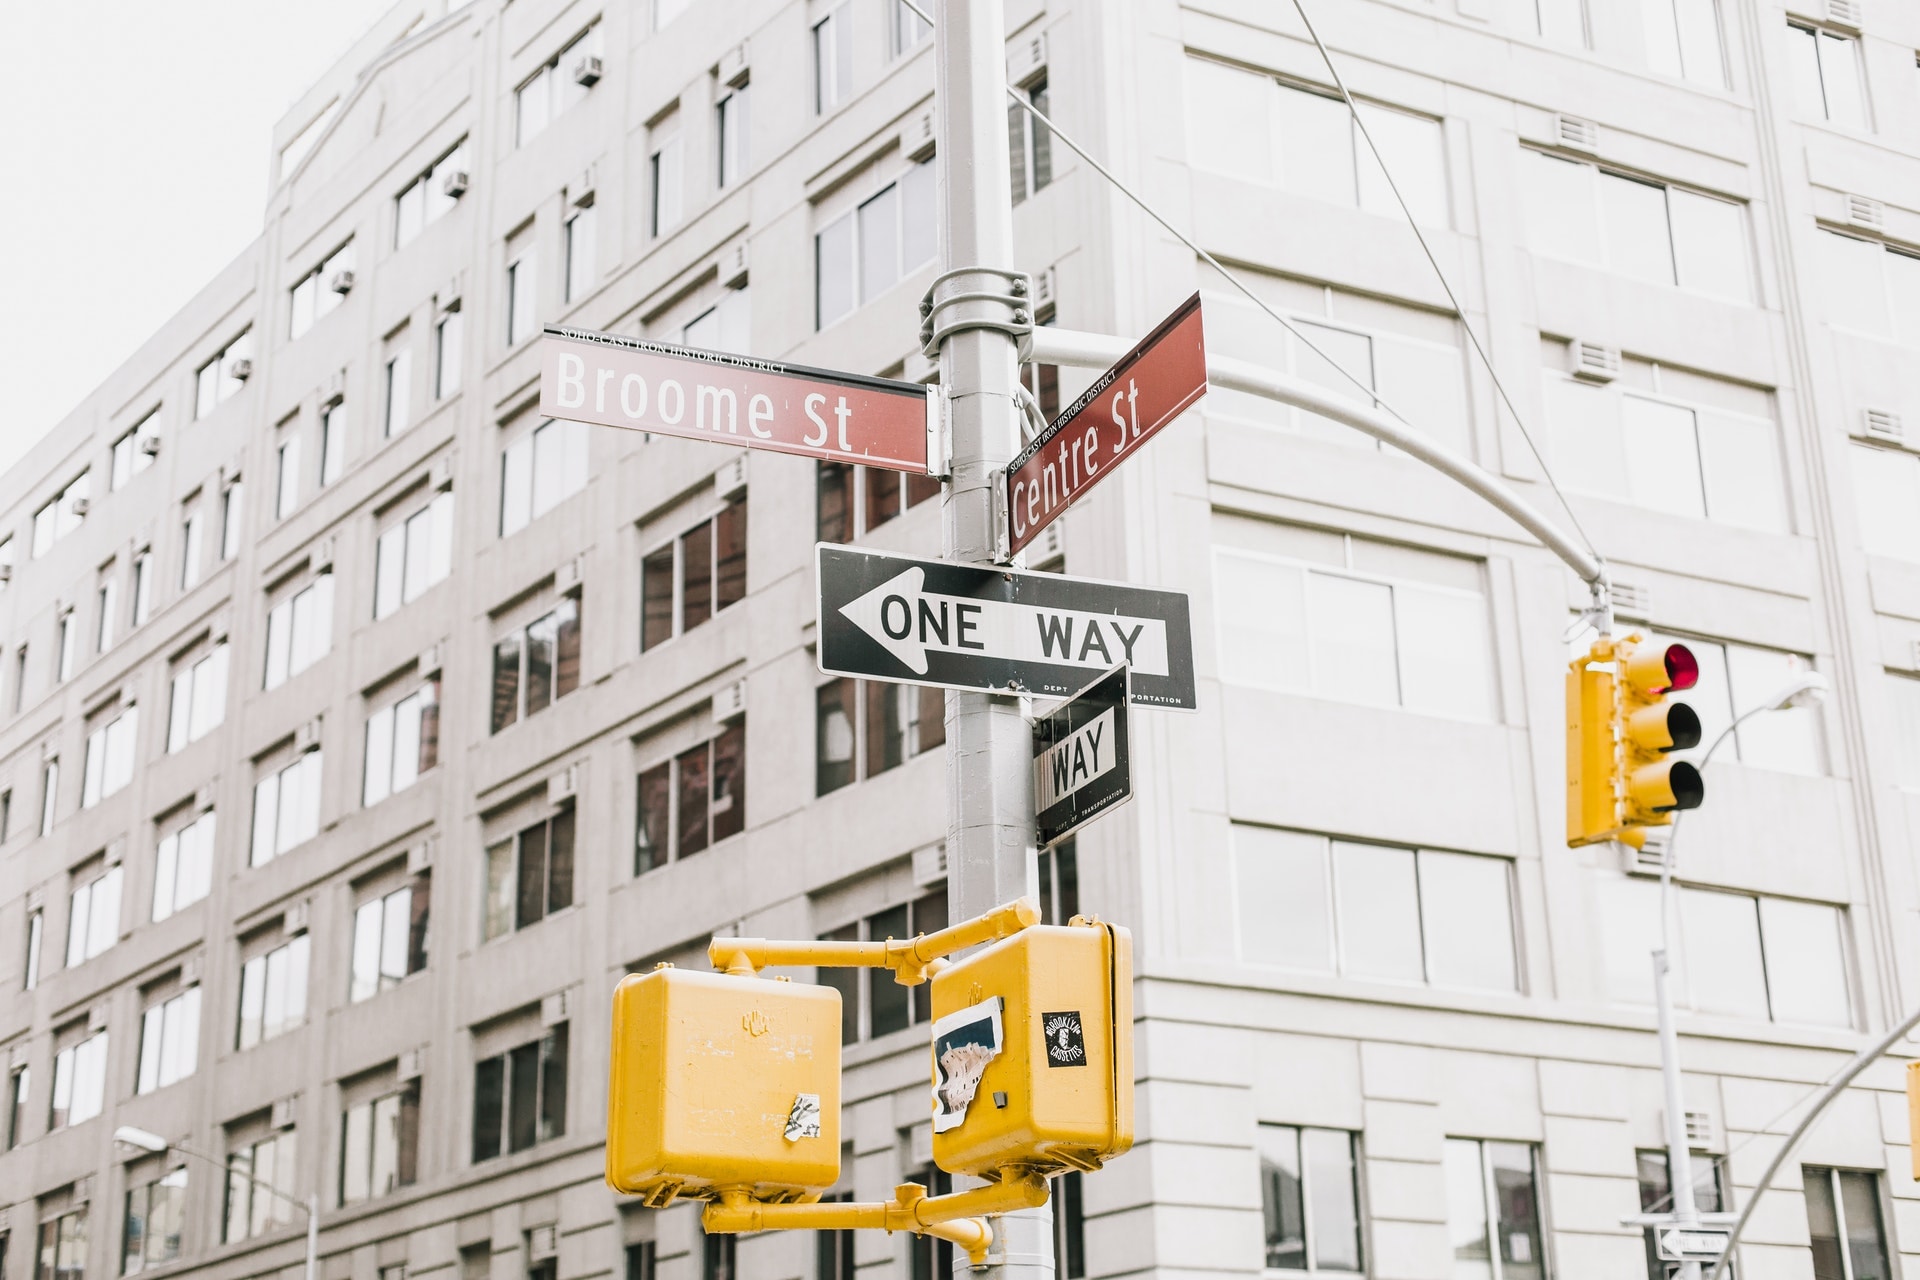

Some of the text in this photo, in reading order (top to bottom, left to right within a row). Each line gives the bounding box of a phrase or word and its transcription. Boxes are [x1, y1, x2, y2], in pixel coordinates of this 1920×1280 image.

[561, 327, 786, 374] SOHO-CAST IRON HISTORIC DISTRICT
[557, 352, 852, 452] Broome St
[1010, 368, 1116, 473] SOHO-CAST IRON HISTORIC DISTRICT
[1012, 377, 1141, 539] Centre St
[880, 594, 1144, 667] ONE WAY
[1044, 685, 1068, 693] DEPT
[1131, 694, 1182, 704] PORTATION
[1051, 721, 1104, 797] WAY
[1071, 814, 1078, 824] OF
[1081, 788, 1123, 816] TRANSPORTATION
[1046, 1017, 1080, 1034] BROOKLYN
[1050, 1045, 1082, 1061] CASSETTES
